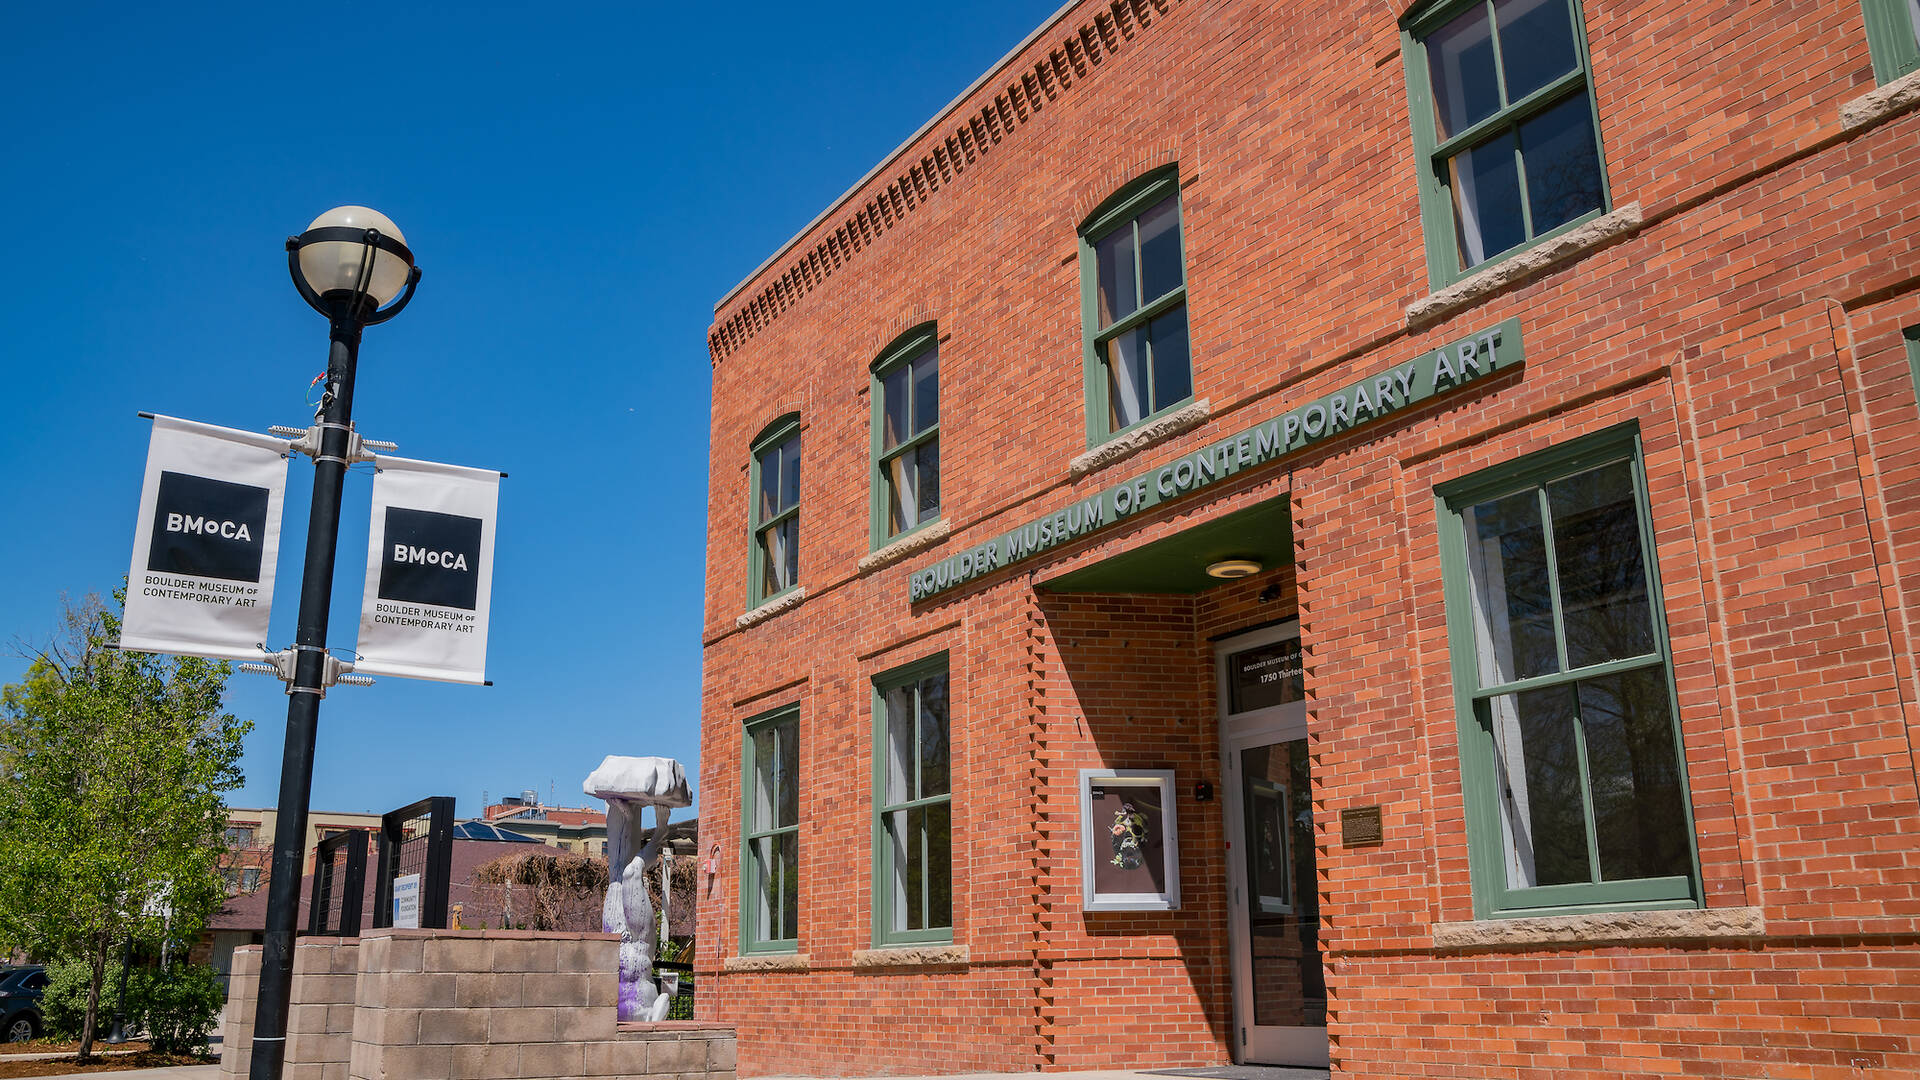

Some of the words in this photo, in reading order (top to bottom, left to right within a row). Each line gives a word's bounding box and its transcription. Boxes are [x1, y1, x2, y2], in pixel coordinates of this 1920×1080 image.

[911, 541, 998, 598] BOULDER
[1006, 495, 1103, 559] MUSEUM
[1114, 478, 1147, 512] OF
[1156, 364, 1416, 497] CONTEMPORARY
[1432, 328, 1503, 386] ART
[166, 512, 252, 542] BMoCA
[393, 544, 468, 572] BMoCA
[145, 575, 195, 590] BOULDER
[199, 582, 244, 595] MUSEUM
[143, 587, 233, 606] CONTEMPORARY
[235, 598, 257, 608] ART
[376, 603, 421, 616] BOULDER
[423, 609, 463, 622] MUSEUM
[374, 614, 453, 632] CONTEMPORARY
[455, 624, 475, 634] ART
[1243, 661, 1266, 672] BOULDER
[1267, 655, 1290, 665] MUSEUM
[1290, 652, 1298, 660] OF
[1260, 672, 1278, 684] 1750
[1278, 667, 1303, 679] Thirtee
